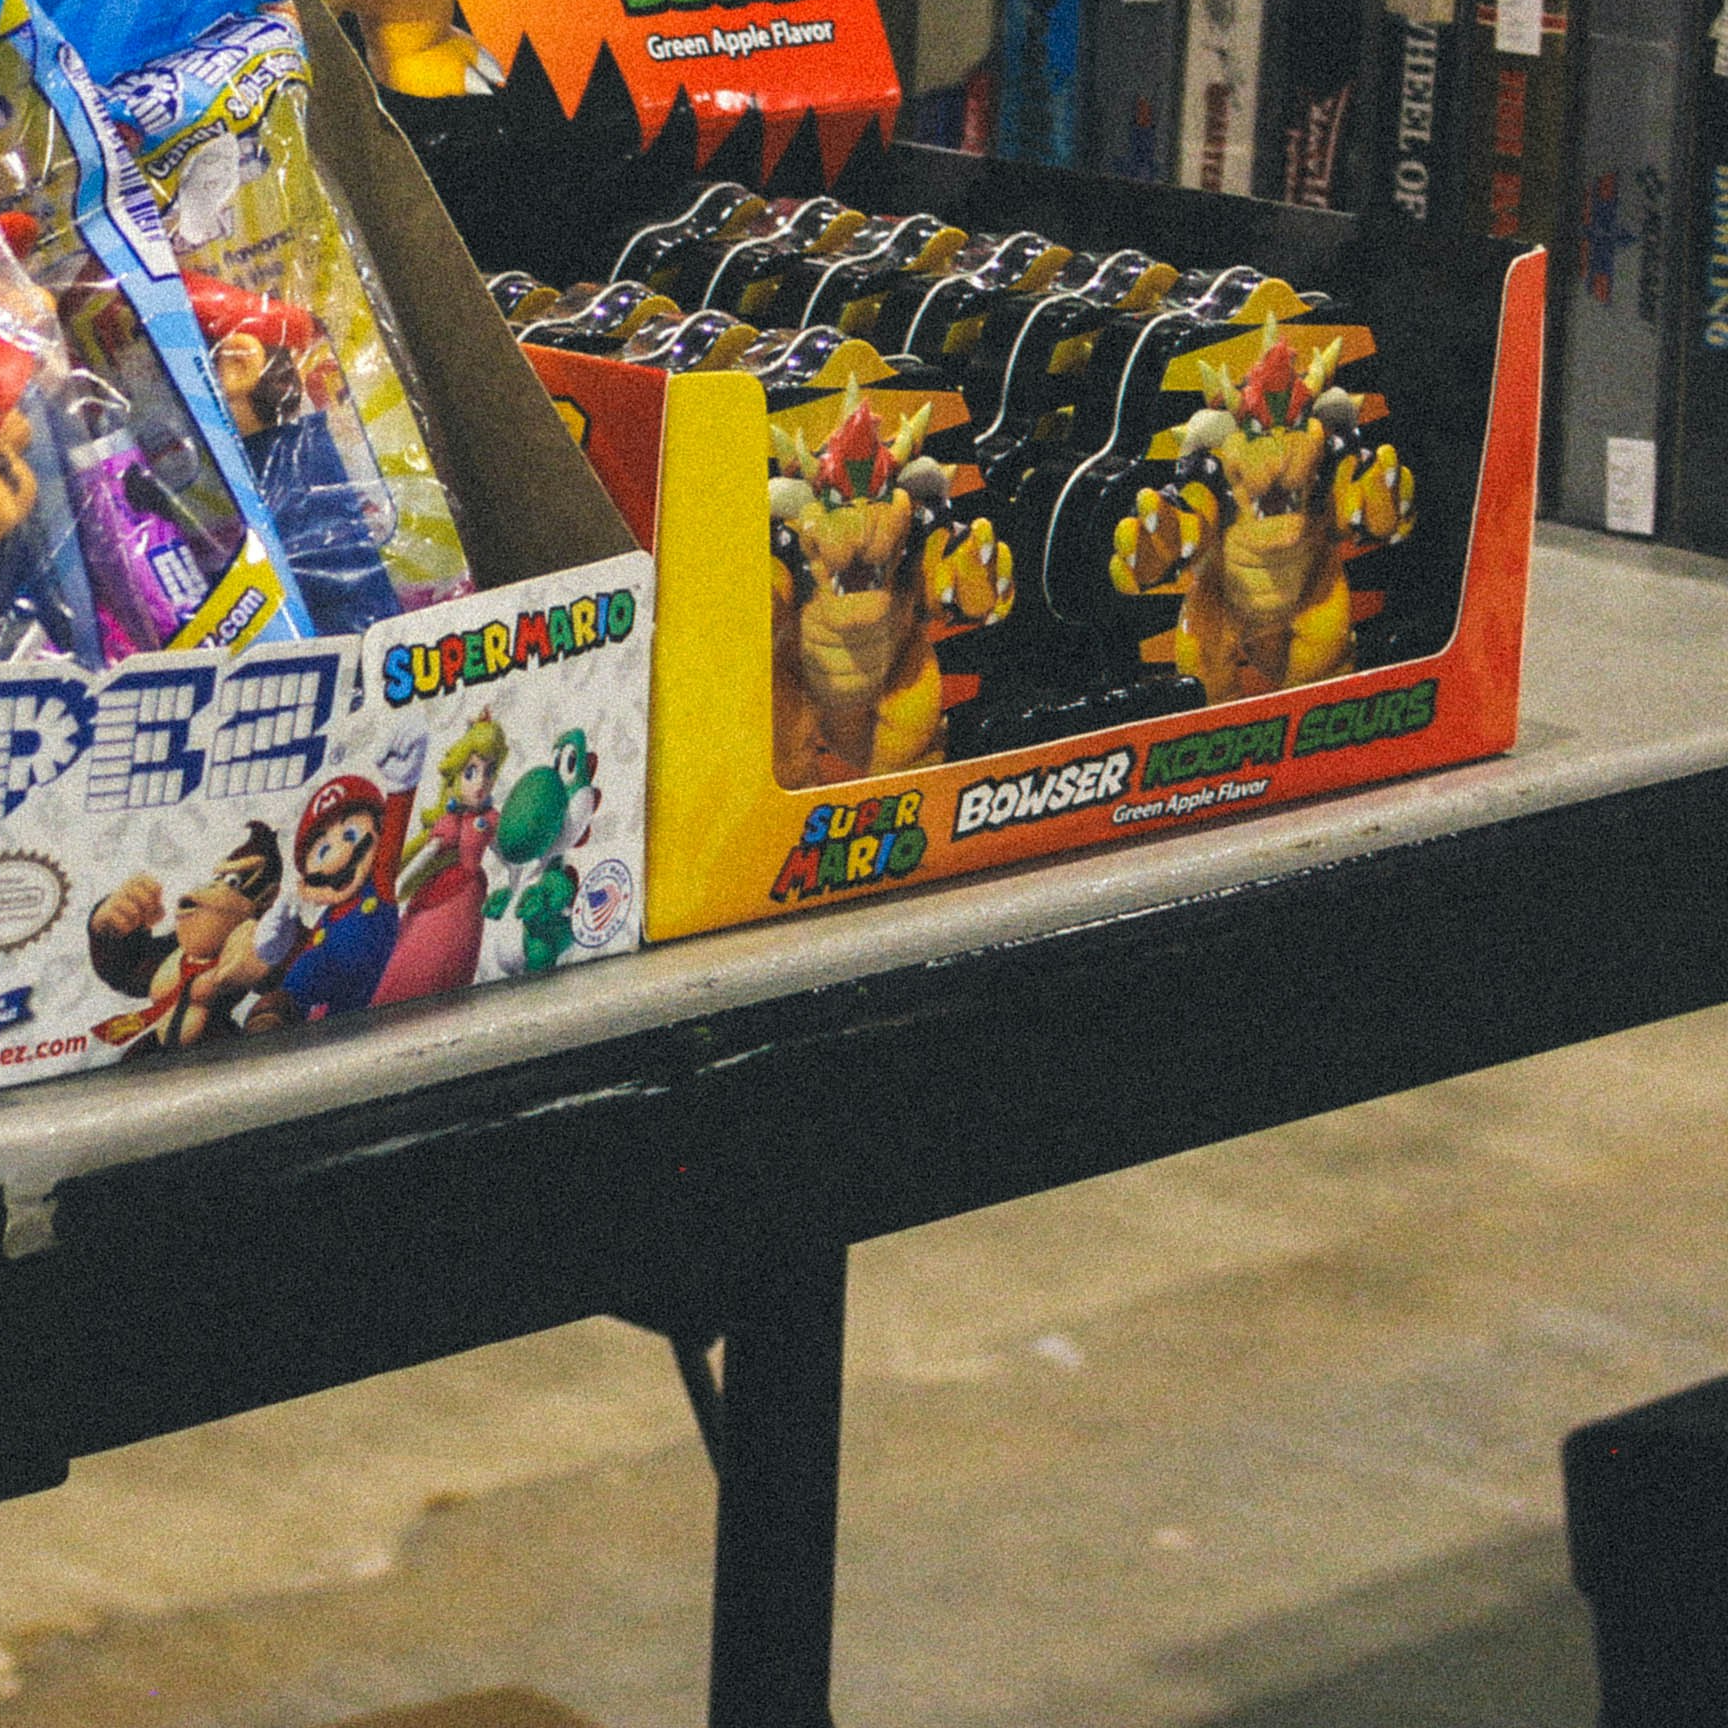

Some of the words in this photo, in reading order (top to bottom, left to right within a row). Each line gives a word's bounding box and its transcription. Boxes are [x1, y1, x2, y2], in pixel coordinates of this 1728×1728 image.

[646, 32, 711, 61] Green
[712, 24, 771, 58] Apple
[772, 19, 835, 48] Flavor
[148, 118, 227, 180] Candy
[1393, 159, 1430, 221] OF
[383, 619, 512, 709] SUPER
[510, 588, 637, 666] MARIO
[952, 746, 1135, 845] BOWSER
[1143, 706, 1288, 790] KOOPA
[1291, 677, 1439, 756] SOURS
[800, 788, 922, 845] SUPER
[1112, 798, 1161, 826] Green
[1163, 791, 1216, 820] Apple
[1217, 777, 1268, 807] Flavor
[770, 823, 928, 903] MARIO
